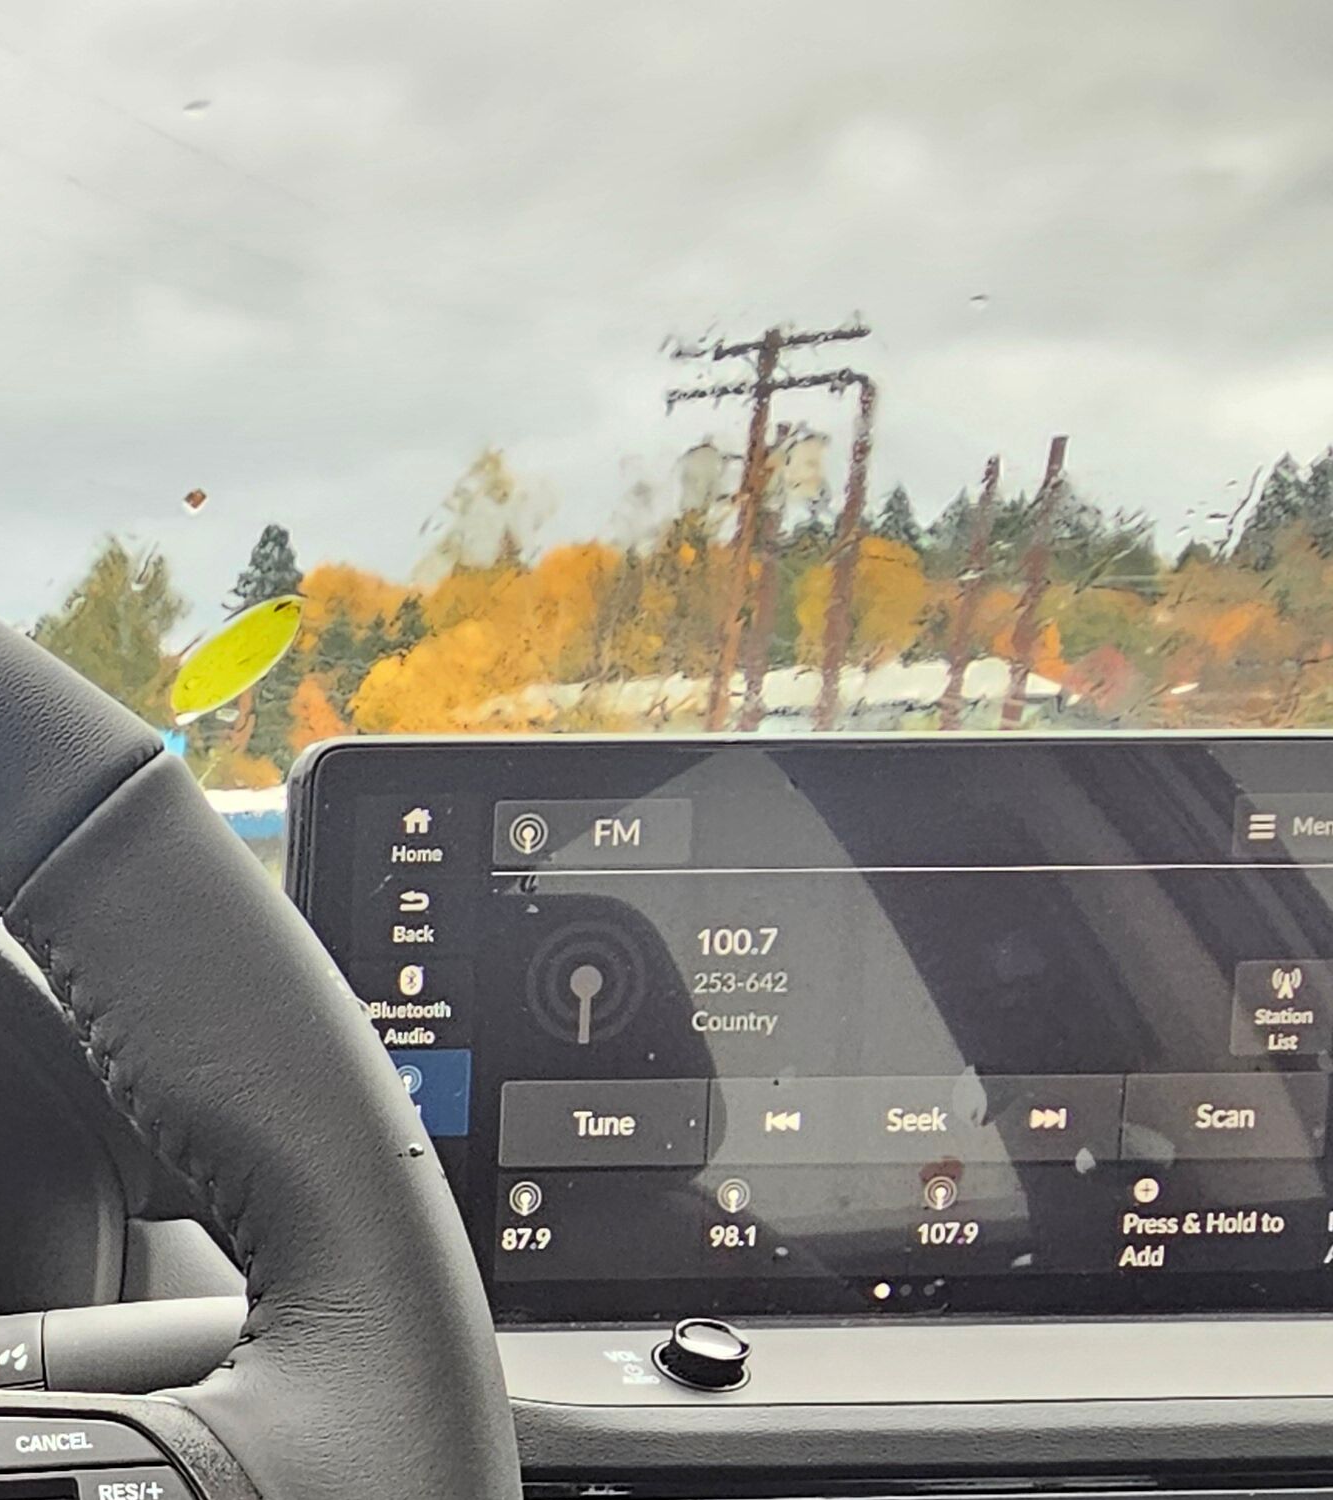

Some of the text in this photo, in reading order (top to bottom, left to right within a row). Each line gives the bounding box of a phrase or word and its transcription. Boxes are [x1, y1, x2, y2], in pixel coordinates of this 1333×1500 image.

[593, 818, 641, 847] FM
[390, 845, 444, 863] Home
[392, 924, 435, 944] Back
[696, 927, 779, 956] 100.7
[693, 971, 788, 994] 253-642
[370, 1001, 452, 1020] Bluetooth
[1254, 1006, 1314, 1026] Station
[691, 1010, 779, 1036] Country
[383, 1027, 436, 1045] Audio
[1267, 1033, 1299, 1051] List
[573, 1110, 636, 1137] Tune
[886, 1107, 948, 1133] Seek
[1194, 1103, 1256, 1130] Scan
[917, 1222, 979, 1246] 107.9
[1123, 1211, 1285, 1235] Press & Hold to
[501, 1227, 552, 1251] 87.9
[710, 1225, 756, 1248] 98.1
[1119, 1245, 1166, 1267] Add
[15, 1432, 93, 1453] CANCEL
